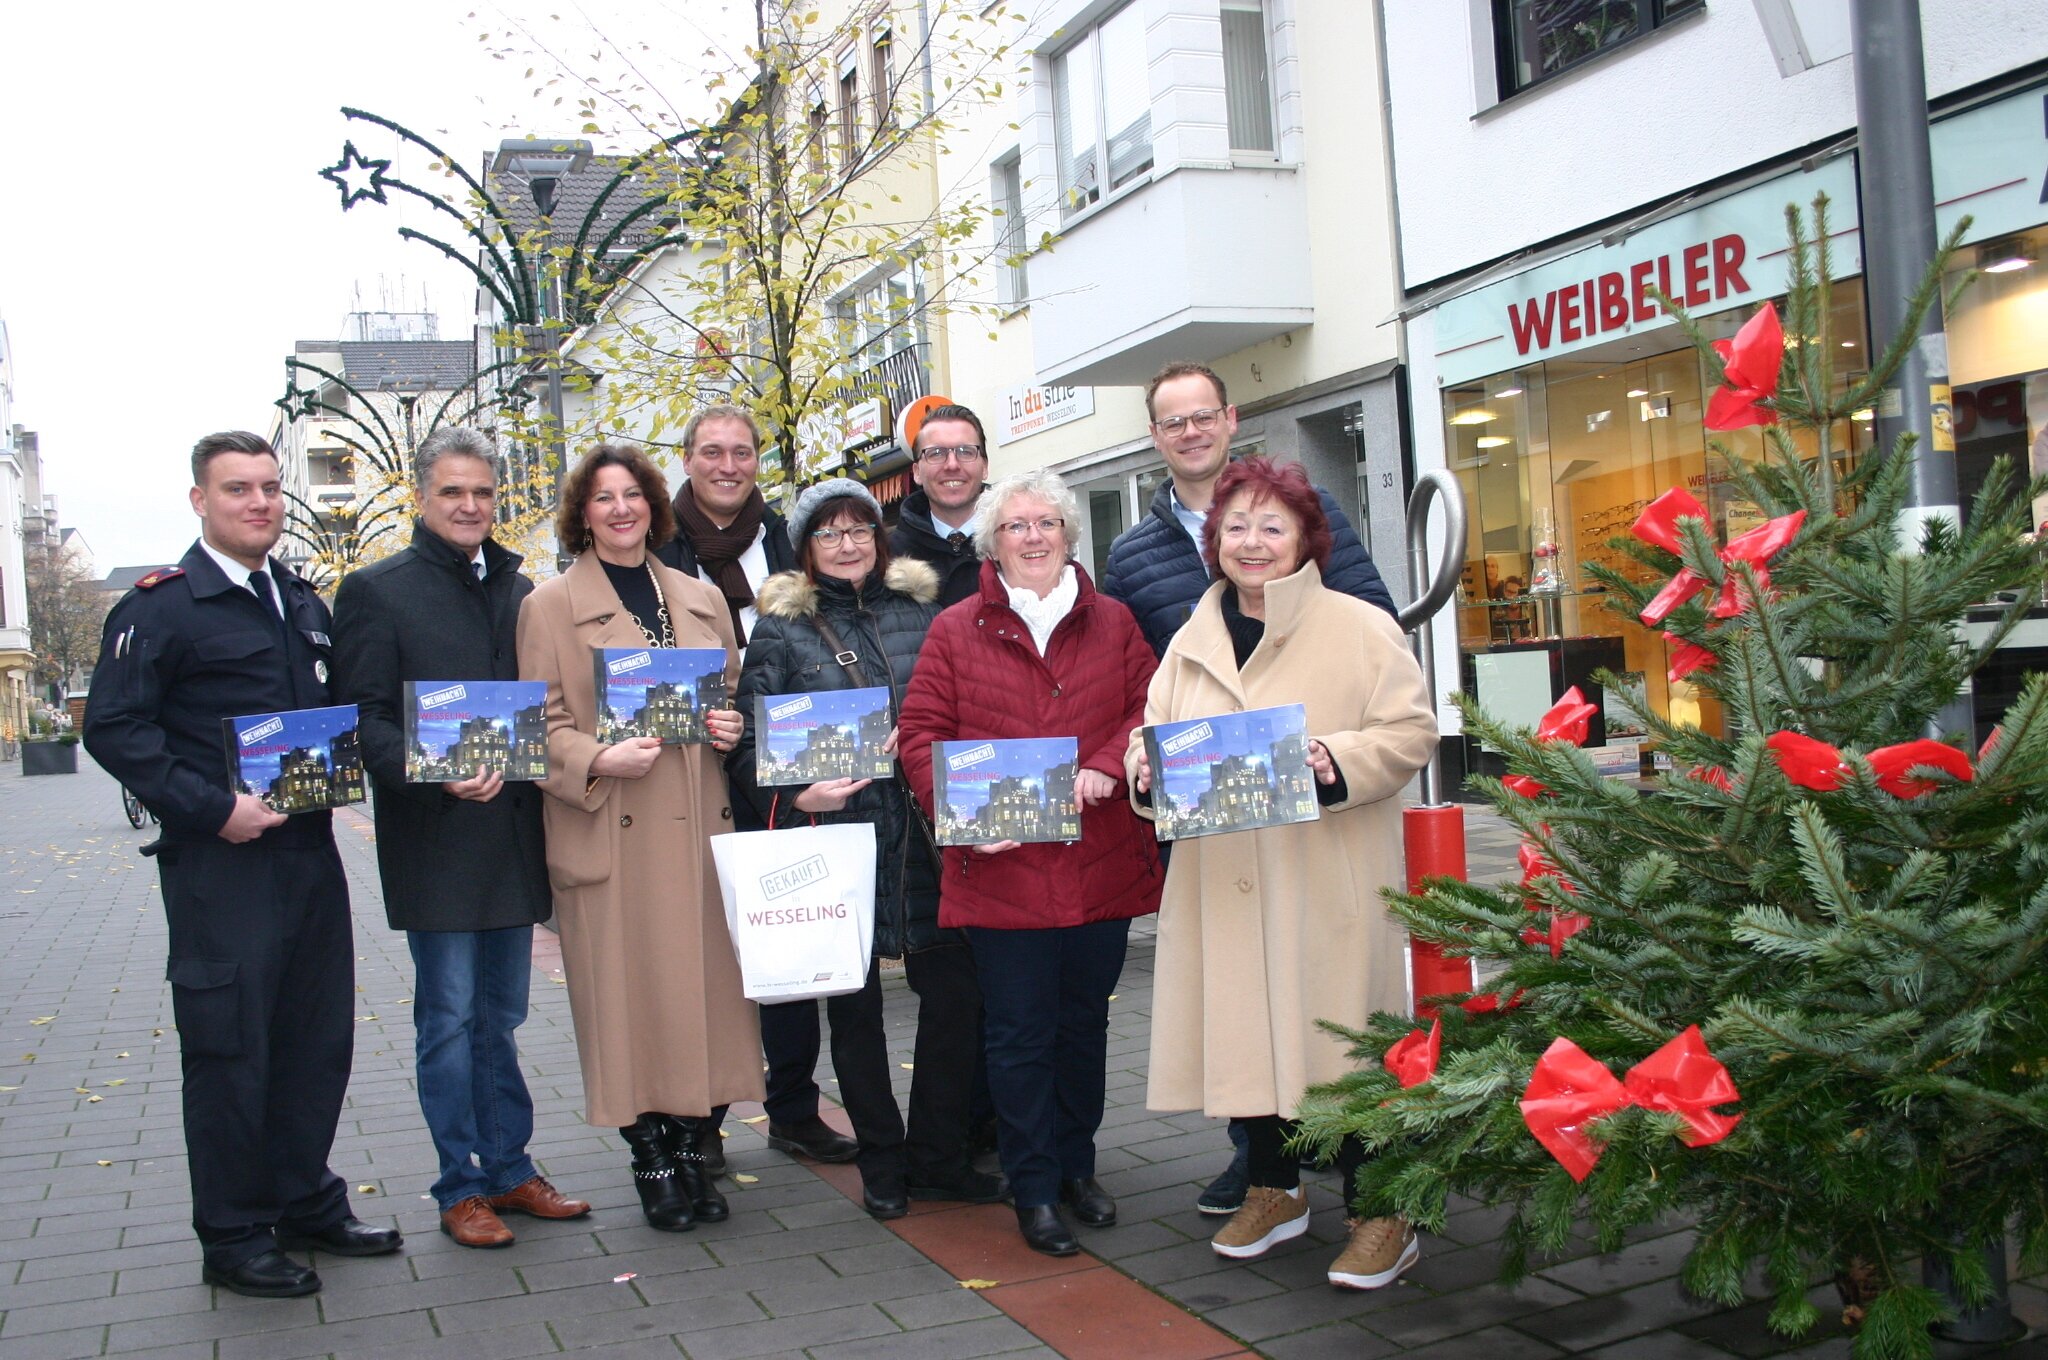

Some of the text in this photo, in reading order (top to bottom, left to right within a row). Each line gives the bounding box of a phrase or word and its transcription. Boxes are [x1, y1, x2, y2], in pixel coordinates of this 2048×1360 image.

[1507, 233, 1752, 356] WEIBELER
[1046, 404, 1077, 424] WESSELING
[1382, 472, 1393, 488] 33
[242, 719, 281, 743] WEIHNACHT
[1165, 725, 1210, 753] WEIHNACHT
[240, 744, 290, 757] WESSELING
[950, 746, 993, 768] WEIHNACHT
[1163, 752, 1222, 768] WESSELING
[765, 859, 824, 895] GEKAUFT
[747, 903, 847, 926] WESSELING
